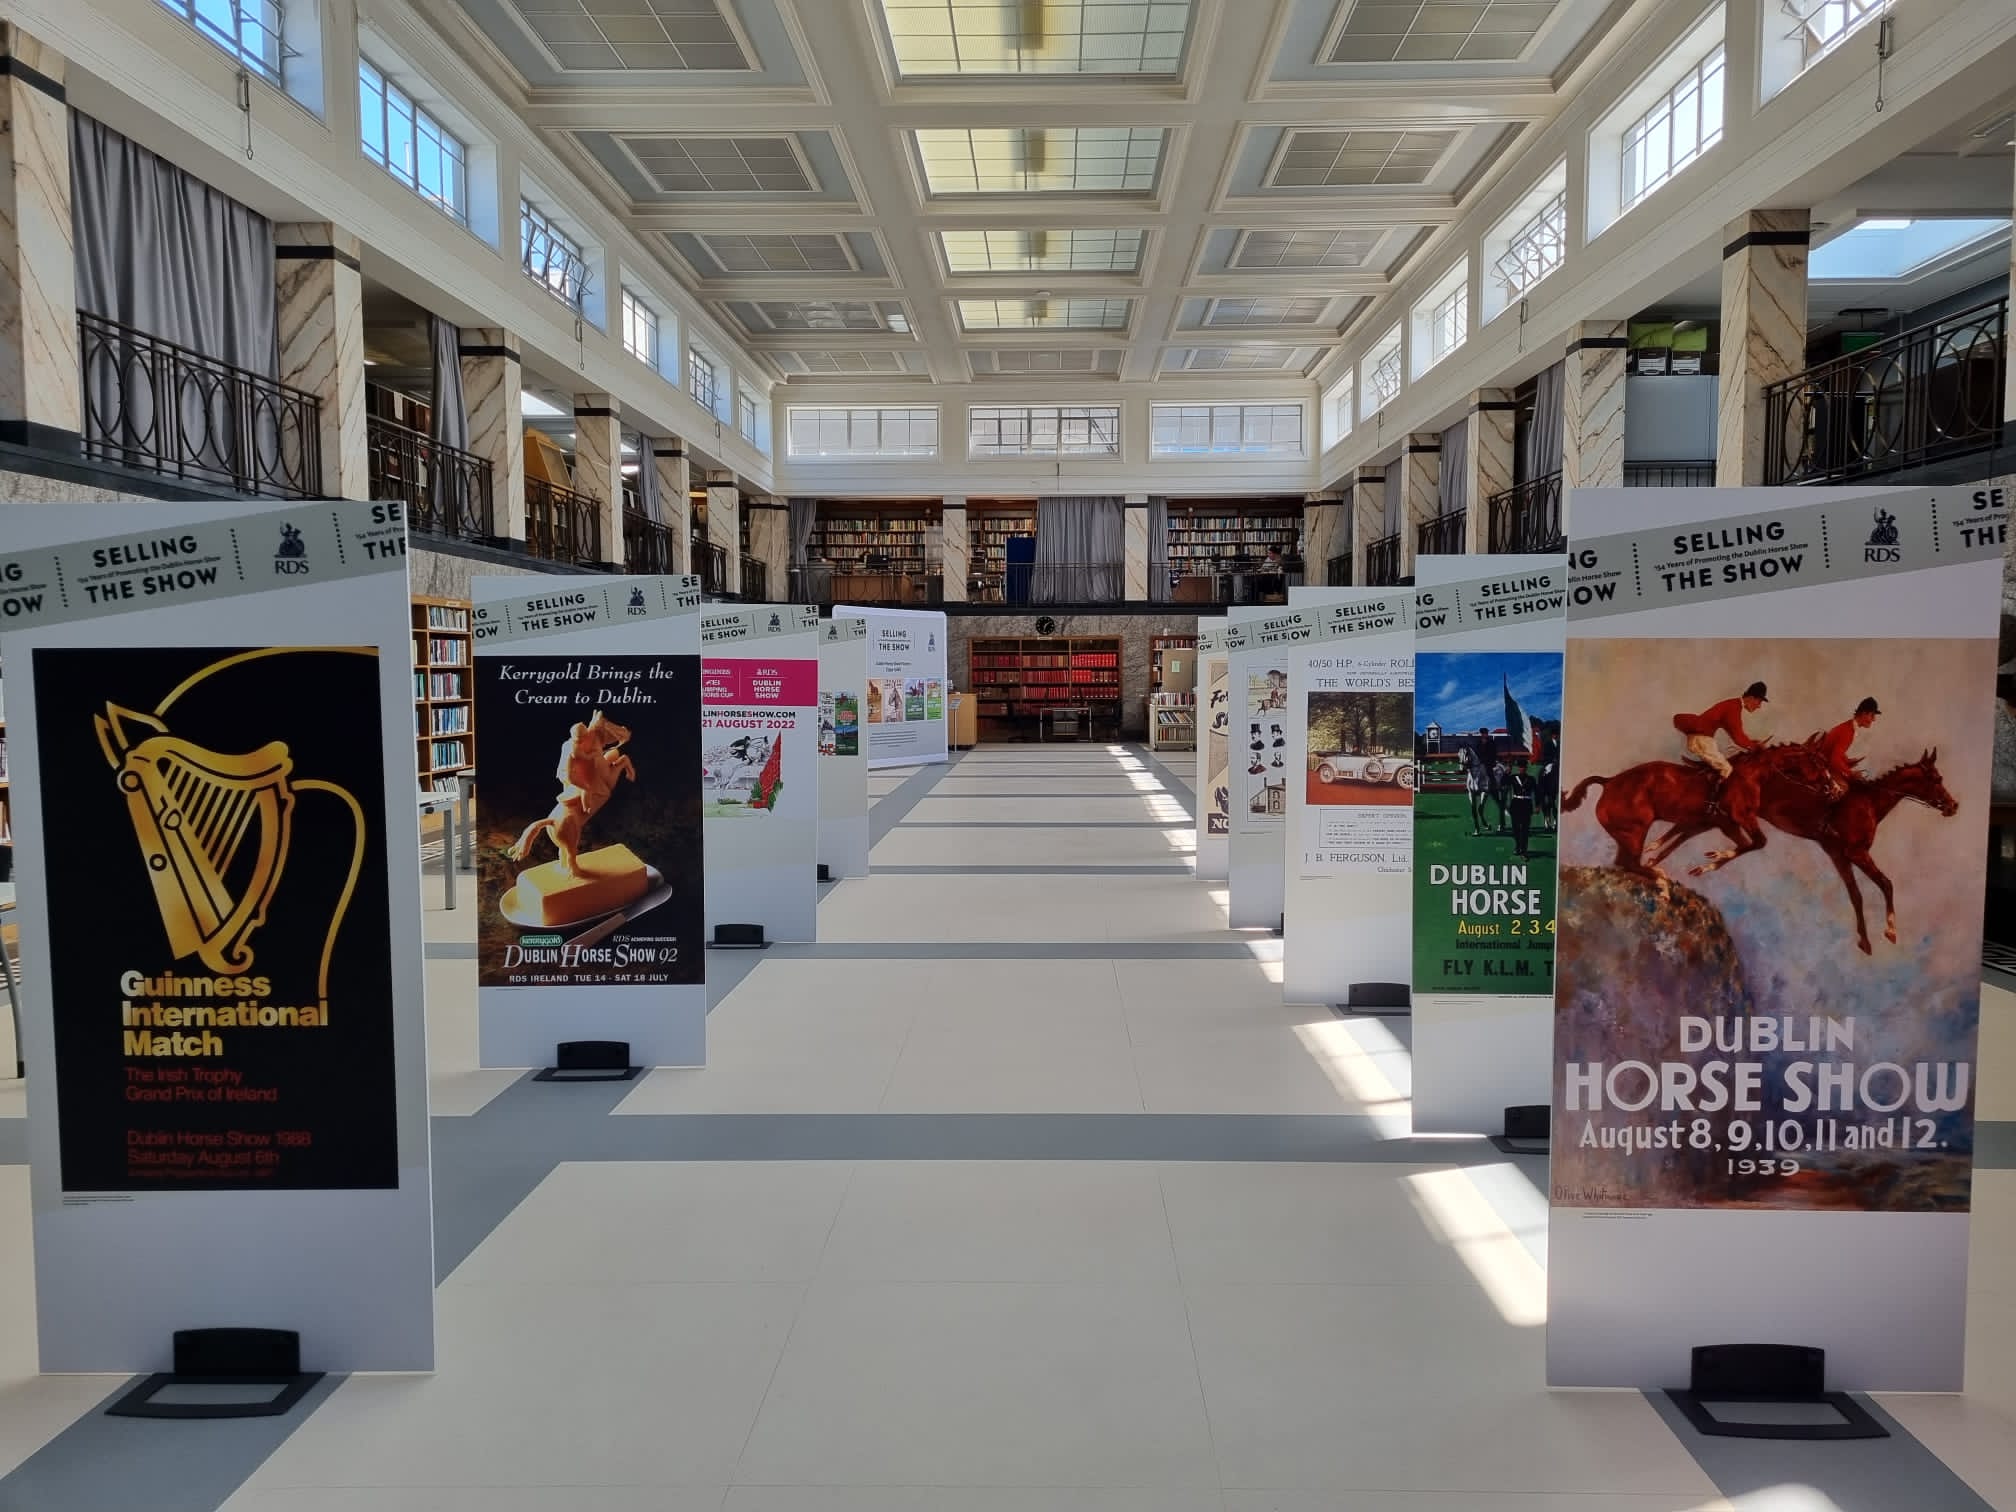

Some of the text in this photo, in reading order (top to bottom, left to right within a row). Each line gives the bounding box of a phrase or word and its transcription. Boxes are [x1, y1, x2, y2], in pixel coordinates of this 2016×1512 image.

[1674, 522, 1785, 555] SELLING
[93, 536, 198, 568] SELLING
[1744, 548, 1767, 558] Dublin
[1864, 548, 1901, 562] RDS
[0, 563, 23, 582] G
[274, 560, 310, 574] RDS
[1662, 554, 1804, 592] THE SHOW
[85, 580, 135, 604] THE
[142, 566, 218, 595] SHOW
[1481, 576, 1551, 598] SELLING
[527, 594, 585, 612] SELLING
[1567, 582, 1616, 607] OW
[0, 594, 44, 618] OW
[627, 607, 647, 616] RDS
[1336, 602, 1386, 618] SELLING
[1474, 604, 1507, 620] THE
[1512, 596, 1563, 615] SHOW
[522, 618, 550, 632] THE
[554, 610, 596, 627] SHOW
[1330, 622, 1354, 634] THE
[1358, 617, 1394, 631] SHOW
[1416, 614, 1446, 630] OW
[472, 626, 498, 640] OW
[718, 628, 747, 639] SHOW
[882, 629, 907, 638] SELLING
[1260, 634, 1279, 644] THE
[1288, 629, 1310, 640] OW
[879, 643, 910, 651] THE SHOW
[1228, 639, 1245, 648] OW
[498, 662, 674, 684] Kerrygold Brings the
[1316, 678, 1338, 688] THE
[514, 686, 657, 704] Cream to Dublin.
[702, 720, 795, 729] 21 AUGUST 2022
[1330, 853, 1386, 862] FERGUSON
[1430, 864, 1527, 886] DUBLIN
[1452, 888, 1542, 916] HORSE
[1458, 920, 1500, 938] August
[503, 944, 678, 968] DUBLIN HORSE SHOW 92
[1443, 960, 1474, 976] FLY
[1484, 960, 1534, 976] K.L.M.
[120, 970, 272, 998] Guinness
[509, 974, 527, 983] RDS
[530, 974, 569, 982] IRELAND
[574, 974, 593, 982] TUE
[615, 974, 632, 982] SAT
[648, 974, 669, 982] JULY
[122, 1000, 328, 1026] International
[123, 1030, 224, 1056] Match
[1680, 1016, 1855, 1054] DUBLIN
[126, 1066, 244, 1086] The Irish Trophy
[126, 1086, 280, 1102] Grand Prix of Ireland
[1565, 1060, 1969, 1112] HORSE SHOW
[127, 1130, 174, 1146] Dublin
[177, 1130, 224, 1146] Horse
[226, 1130, 271, 1146] Show
[1578, 1118, 1684, 1156] August
[1815, 1118, 1836, 1151] 11
[1844, 1117, 1894, 1149] and
[127, 1150, 194, 1168] Saturday
[198, 1150, 252, 1168] August
[1728, 1159, 1800, 1176] 1939
[1582, 1184, 1632, 1201] Whit
